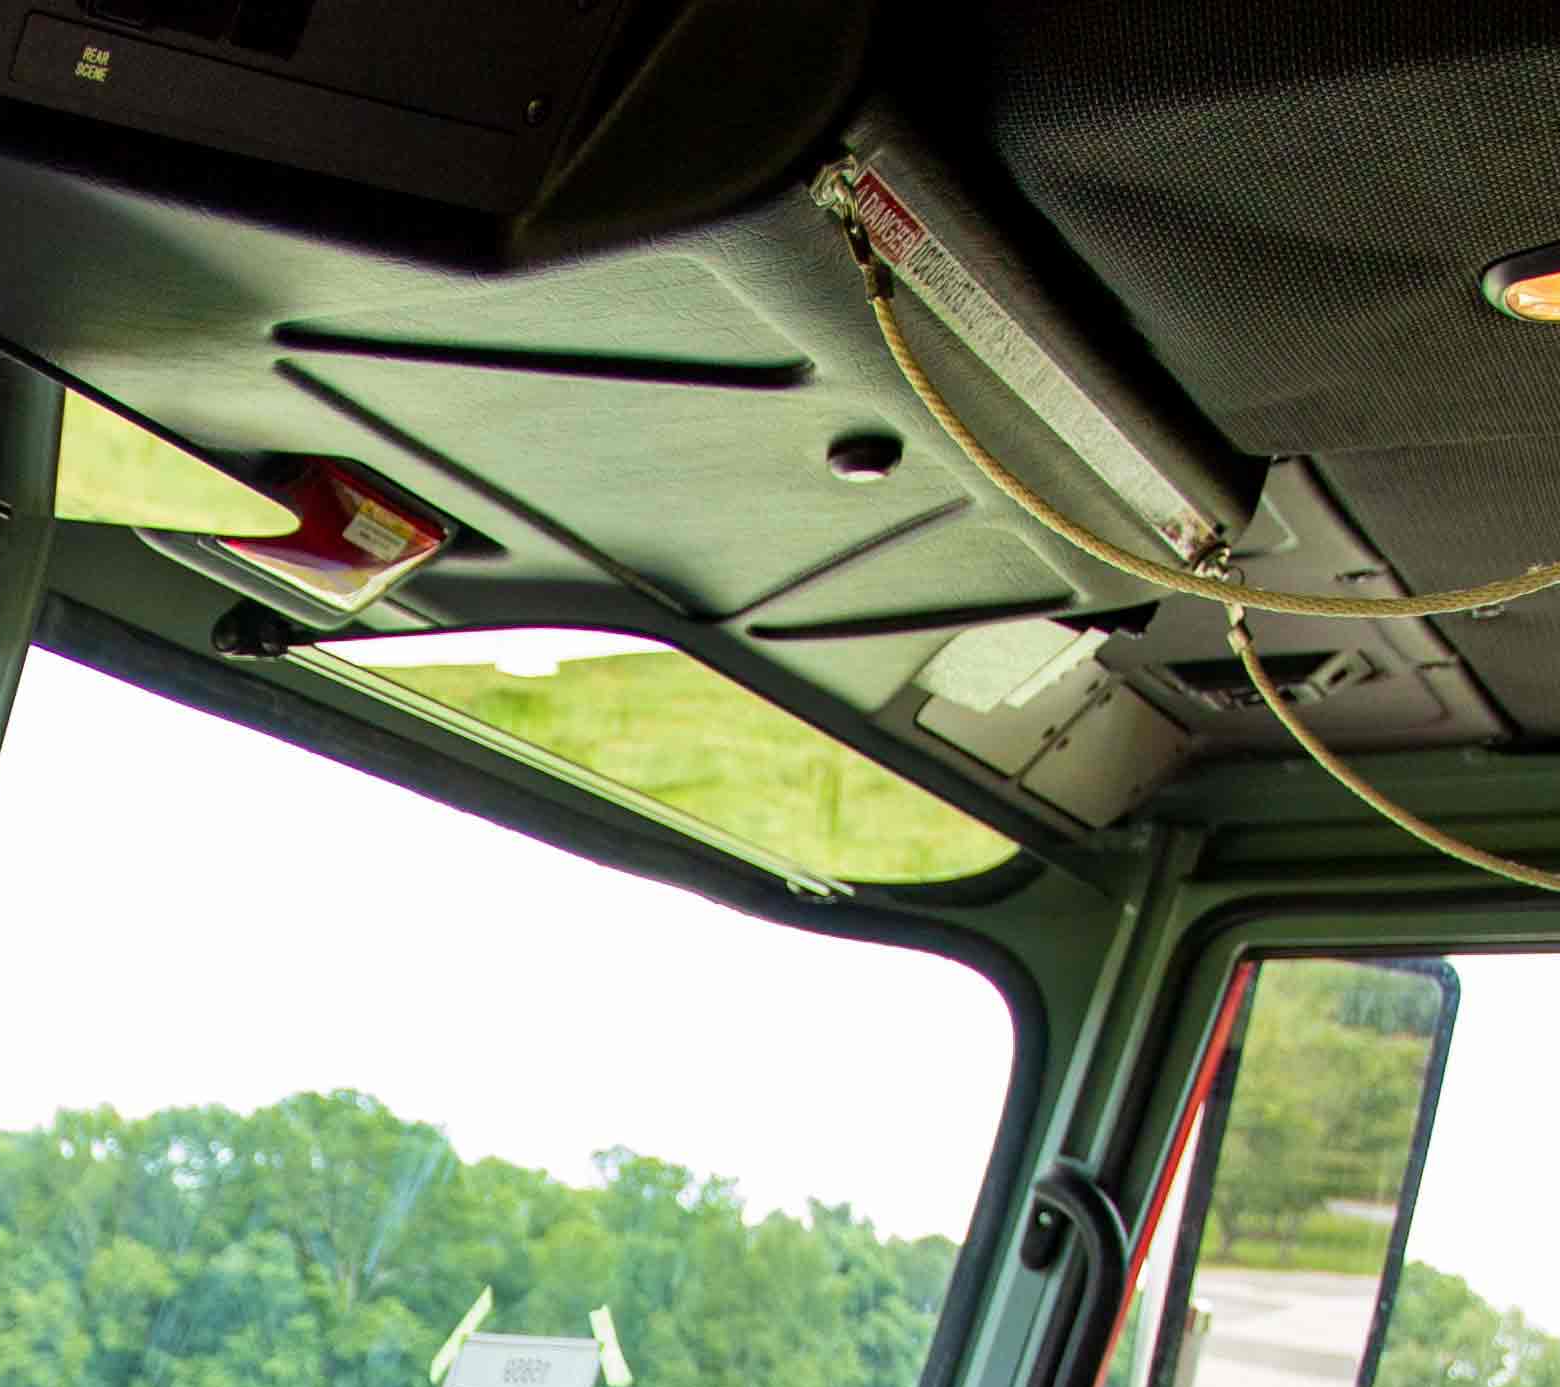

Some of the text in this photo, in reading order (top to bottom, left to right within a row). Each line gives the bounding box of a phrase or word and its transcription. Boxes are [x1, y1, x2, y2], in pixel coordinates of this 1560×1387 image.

[82, 46, 110, 66] REAR
[75, 61, 107, 82] SCENE
[860, 194, 920, 262] DANGER
